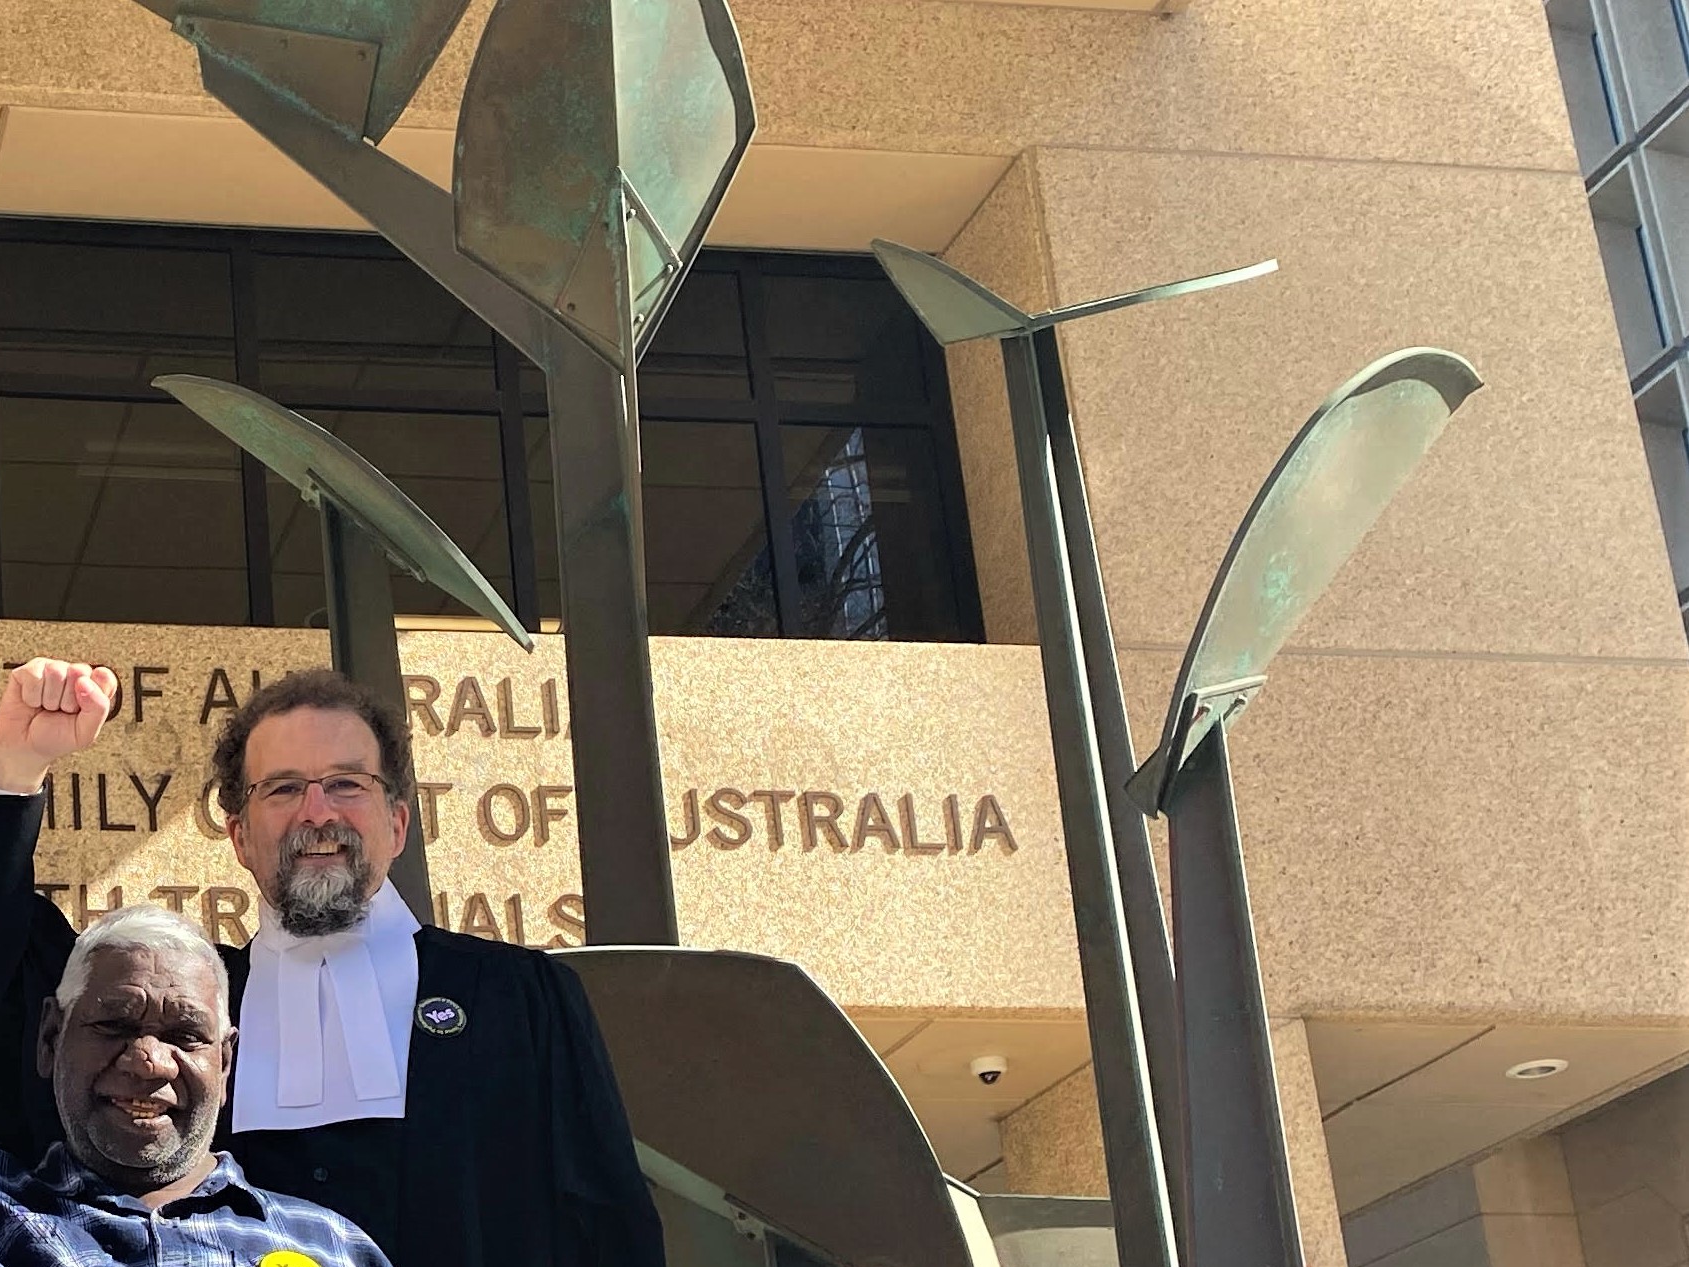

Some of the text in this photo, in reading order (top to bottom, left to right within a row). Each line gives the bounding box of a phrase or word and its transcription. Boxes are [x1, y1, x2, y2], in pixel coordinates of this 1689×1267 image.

[91, 662, 170, 723] F
[199, 667, 573, 740] ARALI
[477, 783, 573, 848] OF
[670, 787, 1019, 857] USTRALIA
[148, 884, 586, 949] TRALS
[425, 1008, 455, 1024] Yes
